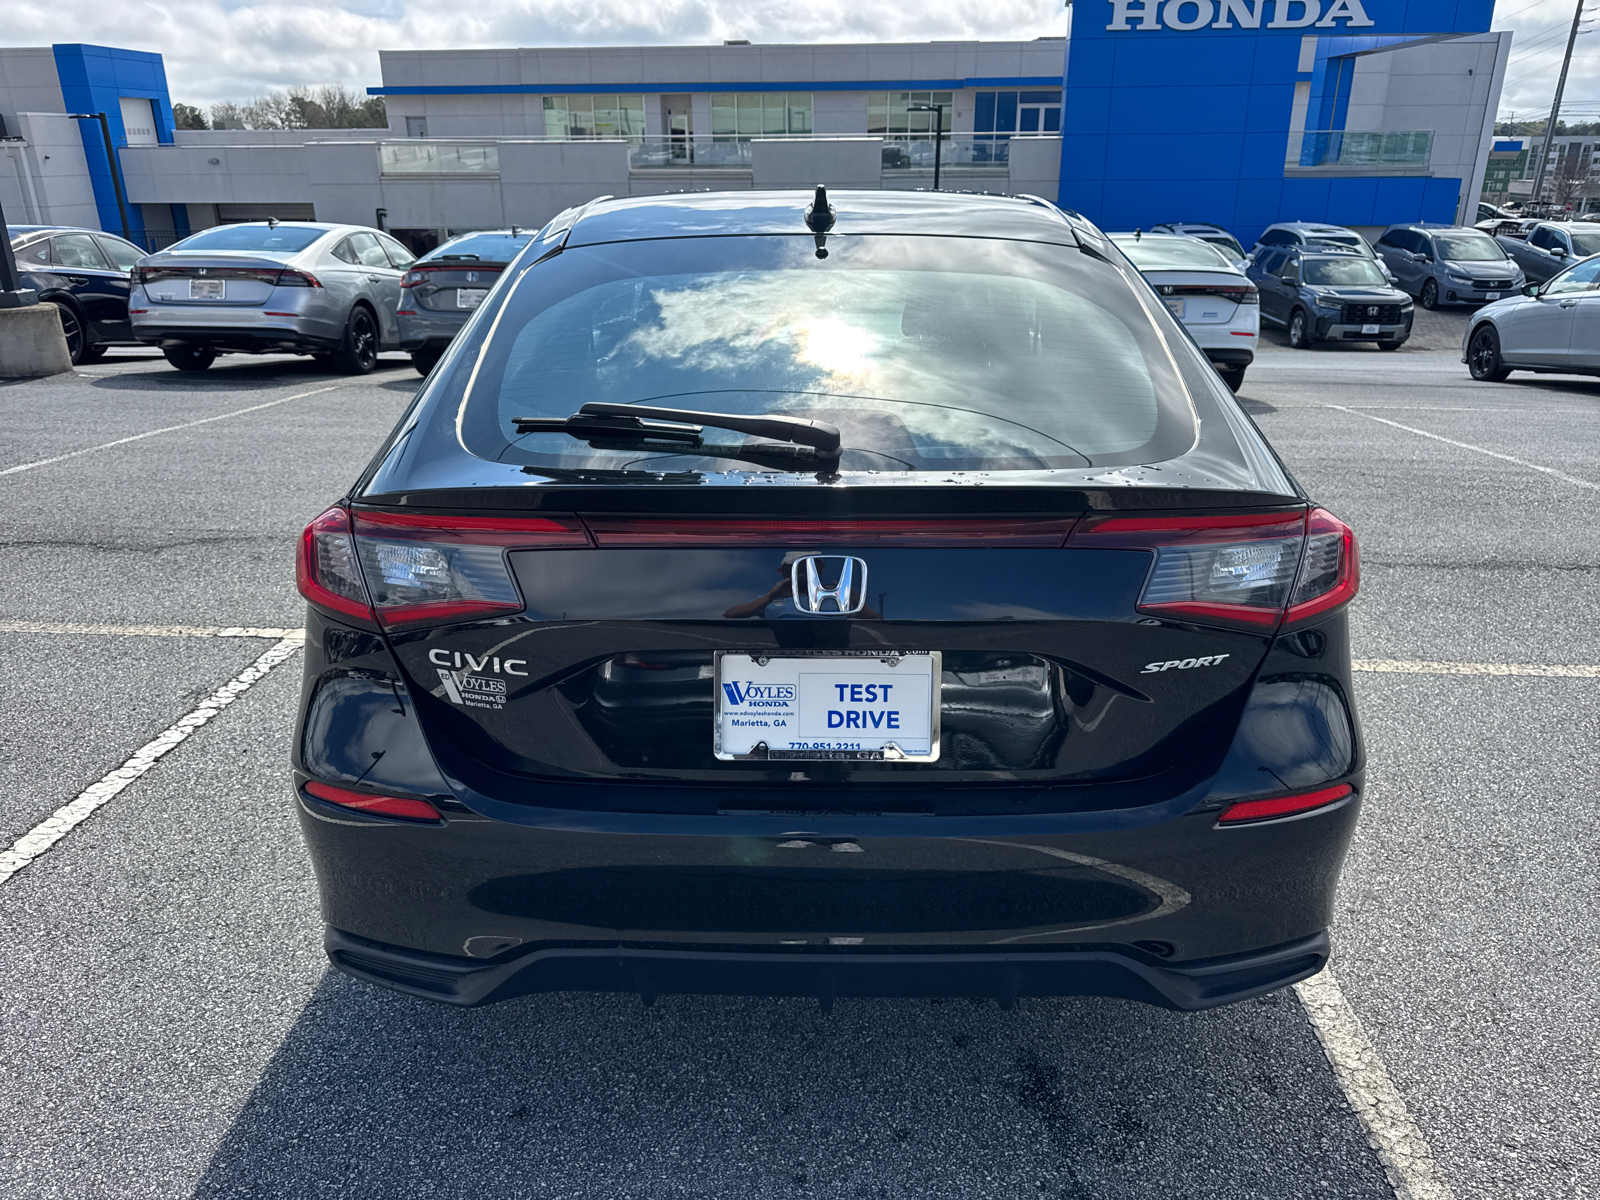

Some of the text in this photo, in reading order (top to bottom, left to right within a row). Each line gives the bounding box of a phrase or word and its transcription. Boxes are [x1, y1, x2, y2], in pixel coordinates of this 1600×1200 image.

[1106, 0, 1375, 31] HONDA
[429, 649, 528, 676] CIVIC
[1140, 653, 1230, 674] SPORT
[451, 670, 505, 692] VOYLES
[461, 692, 496, 702] HONDA
[731, 681, 793, 703] VOYLES
[834, 683, 893, 703] TEST
[731, 719, 771, 728] Marietta,
[827, 710, 900, 729] DRIVE
[788, 742, 861, 750] 770-951-2211
